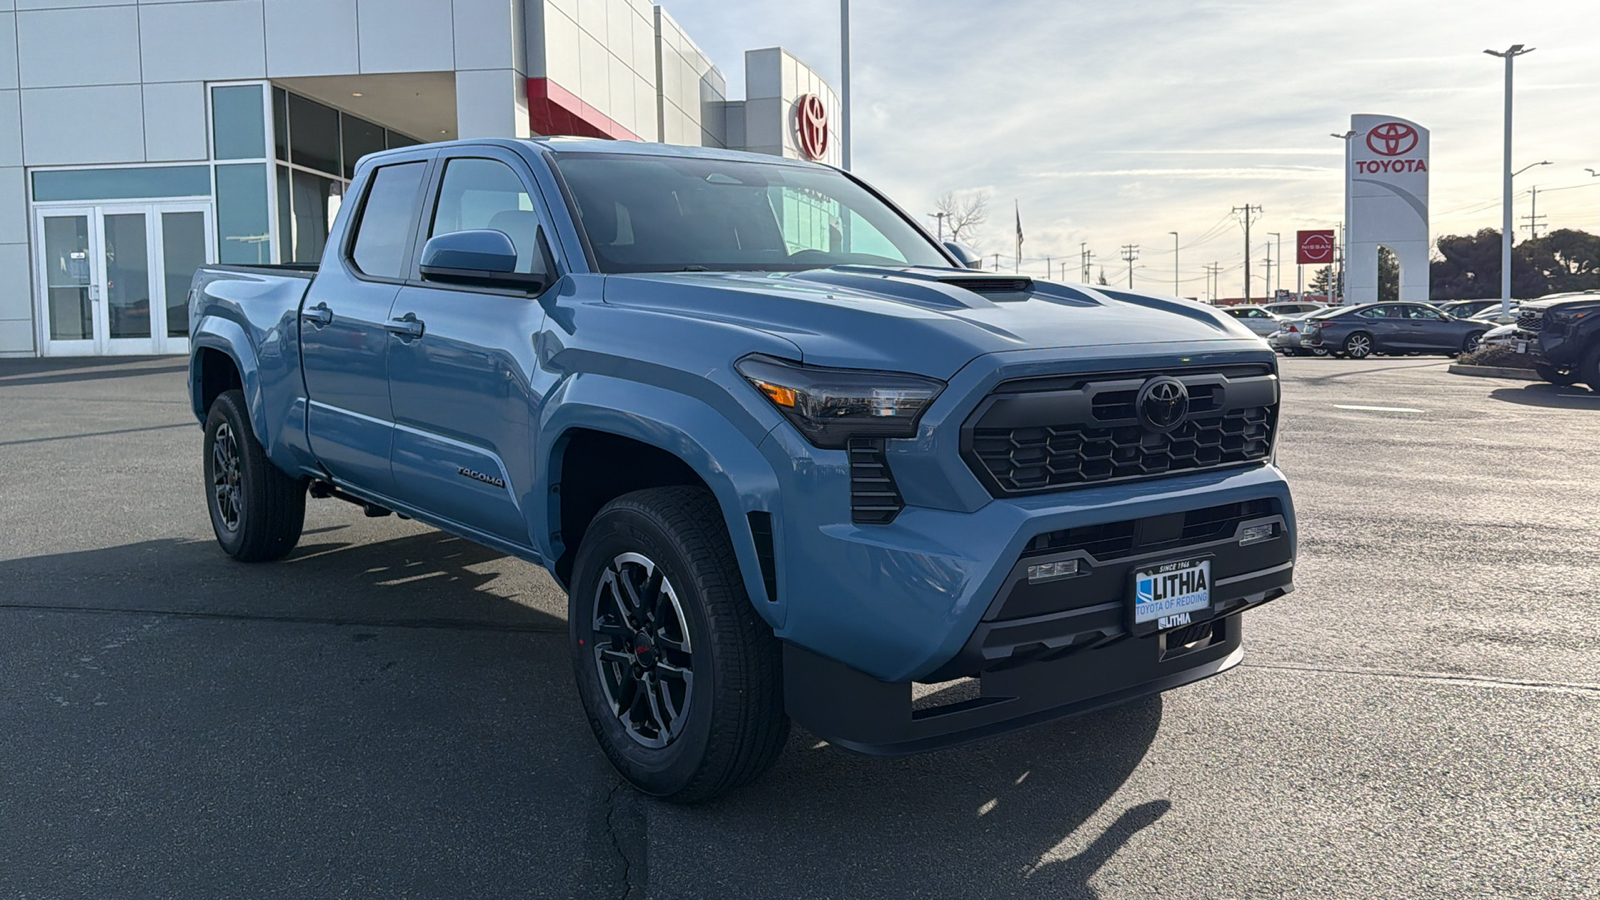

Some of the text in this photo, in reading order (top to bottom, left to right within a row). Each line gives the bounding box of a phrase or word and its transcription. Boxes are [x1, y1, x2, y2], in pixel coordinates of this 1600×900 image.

[1356, 159, 1427, 174] TOYOTA
[457, 466, 505, 488] TACOMA
[1159, 563, 1177, 573] SINCE
[1153, 569, 1207, 601] LITHIA
[1136, 592, 1208, 616] TOYOTA OF REDDING
[1164, 612, 1191, 628] LITHIA
